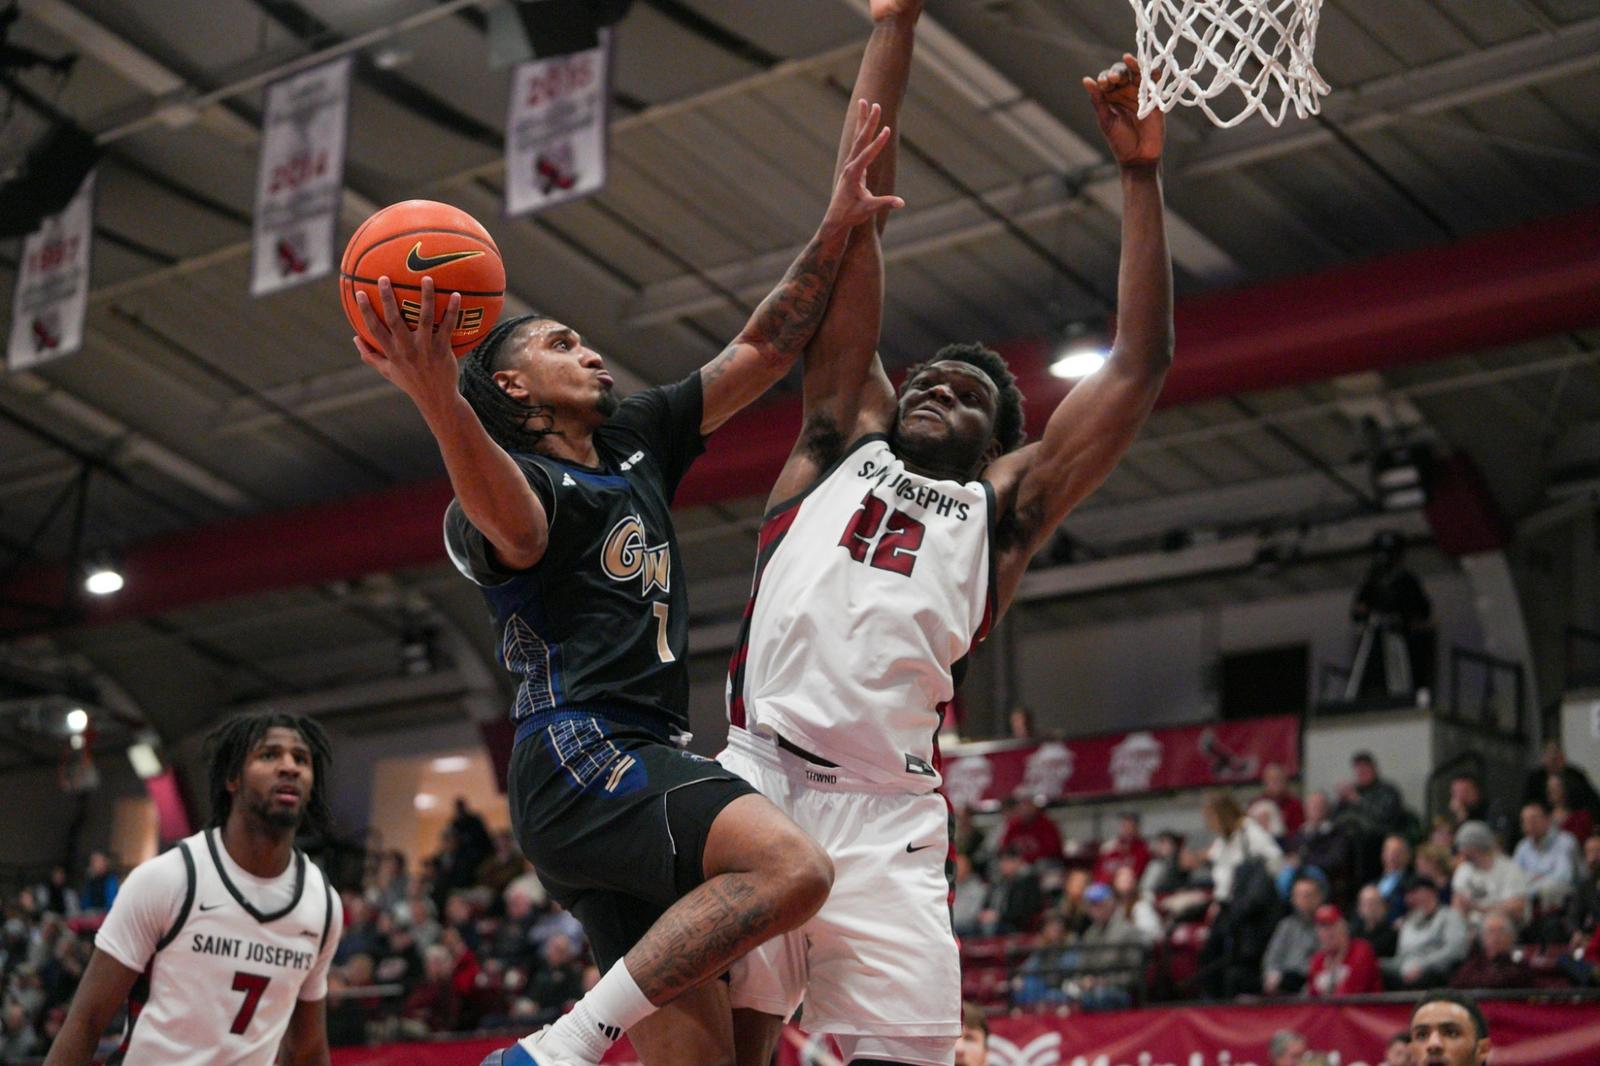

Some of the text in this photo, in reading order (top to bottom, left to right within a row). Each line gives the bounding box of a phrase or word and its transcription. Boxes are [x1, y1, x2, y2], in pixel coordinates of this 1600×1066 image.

[887, 473, 970, 521] JOSEPH'S
[600, 513, 671, 597] GW
[838, 488, 926, 577] 22
[652, 601, 676, 663] 1
[192, 934, 314, 970] SAINT JOSEPH'S
[229, 971, 272, 1035] 7
